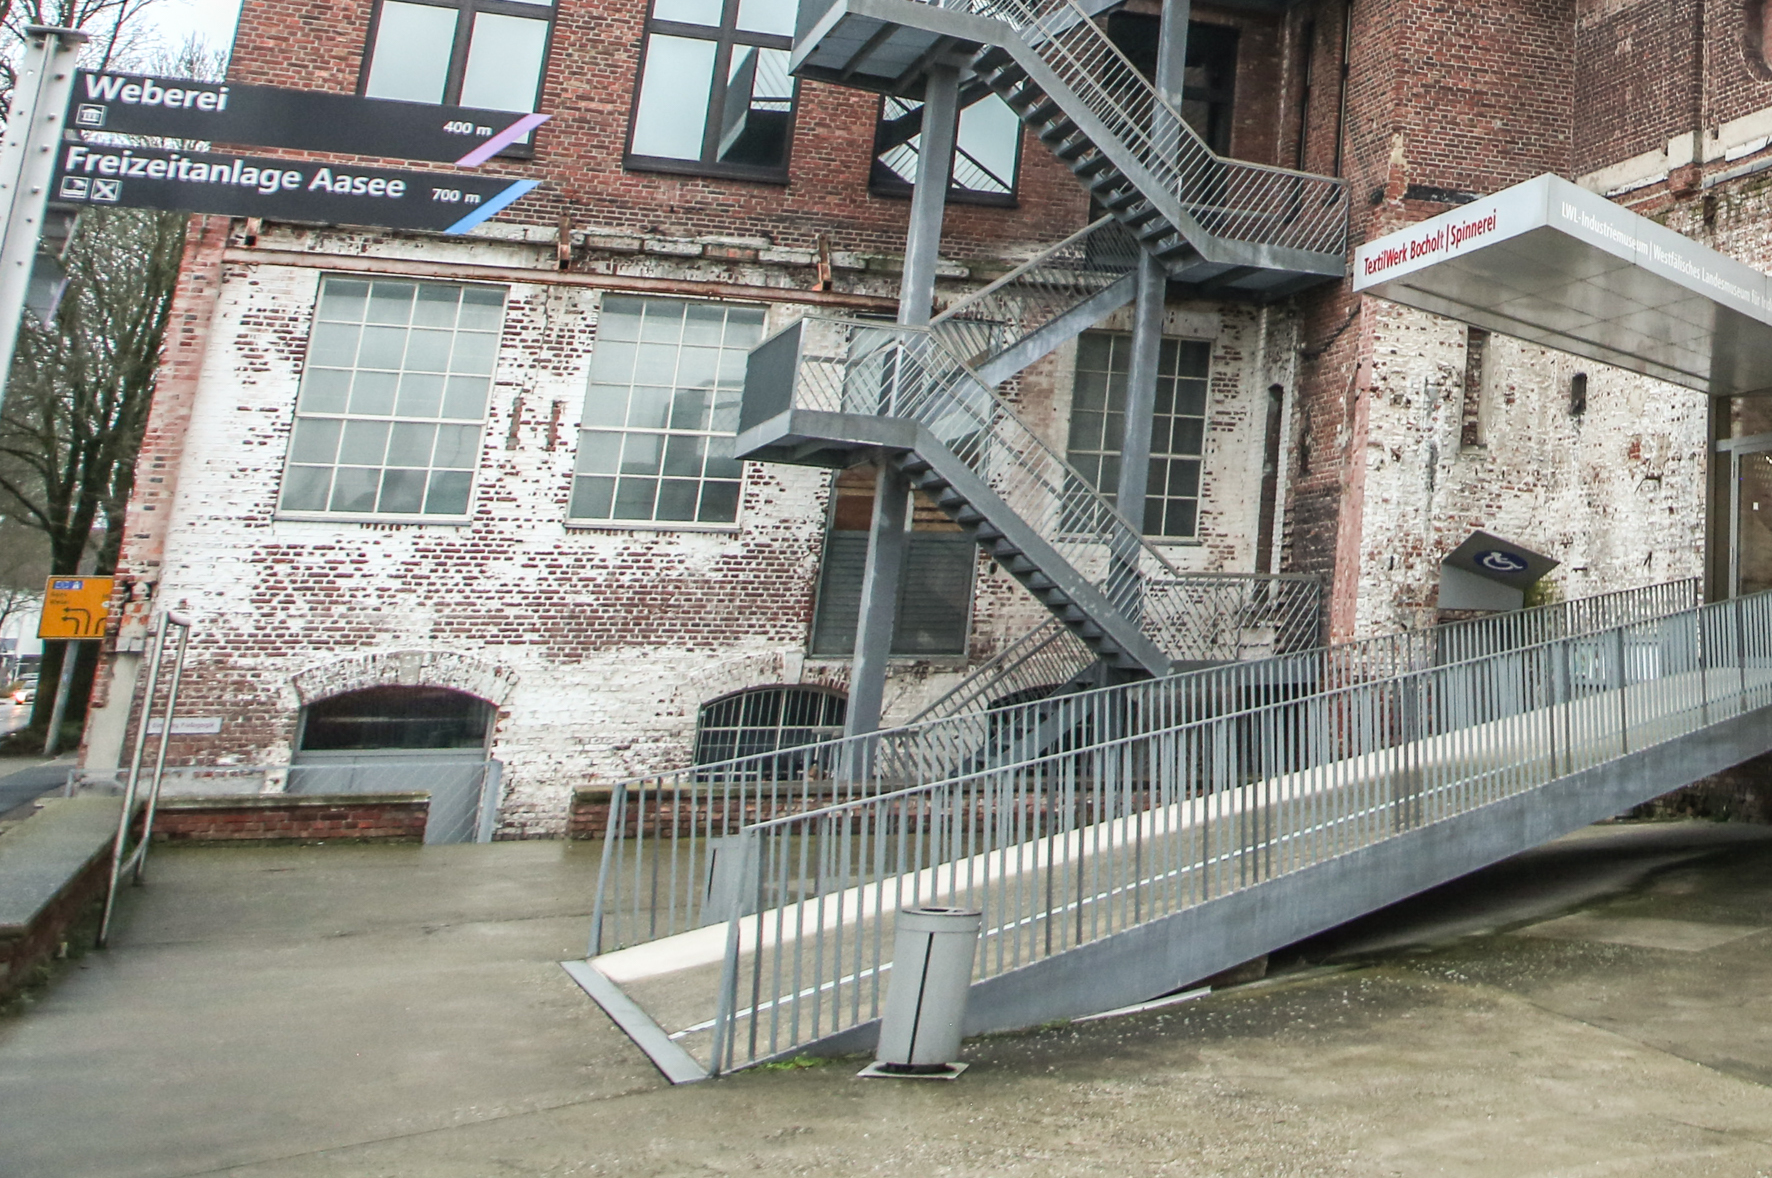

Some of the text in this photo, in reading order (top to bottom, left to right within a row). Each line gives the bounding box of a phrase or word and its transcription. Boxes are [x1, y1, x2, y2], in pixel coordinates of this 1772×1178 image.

[85, 73, 493, 137] Weberei 400 m
[65, 145, 482, 204] Freizeitanlage Aasee 700 m
[1364, 208, 1497, 276] TextilWerk Bocholt Spinnerei
[1561, 201, 1649, 255] LWL-Industriemuseum
[1653, 243, 1701, 280] Westfälisches
[1701, 266, 1751, 302] Landesmuseum
